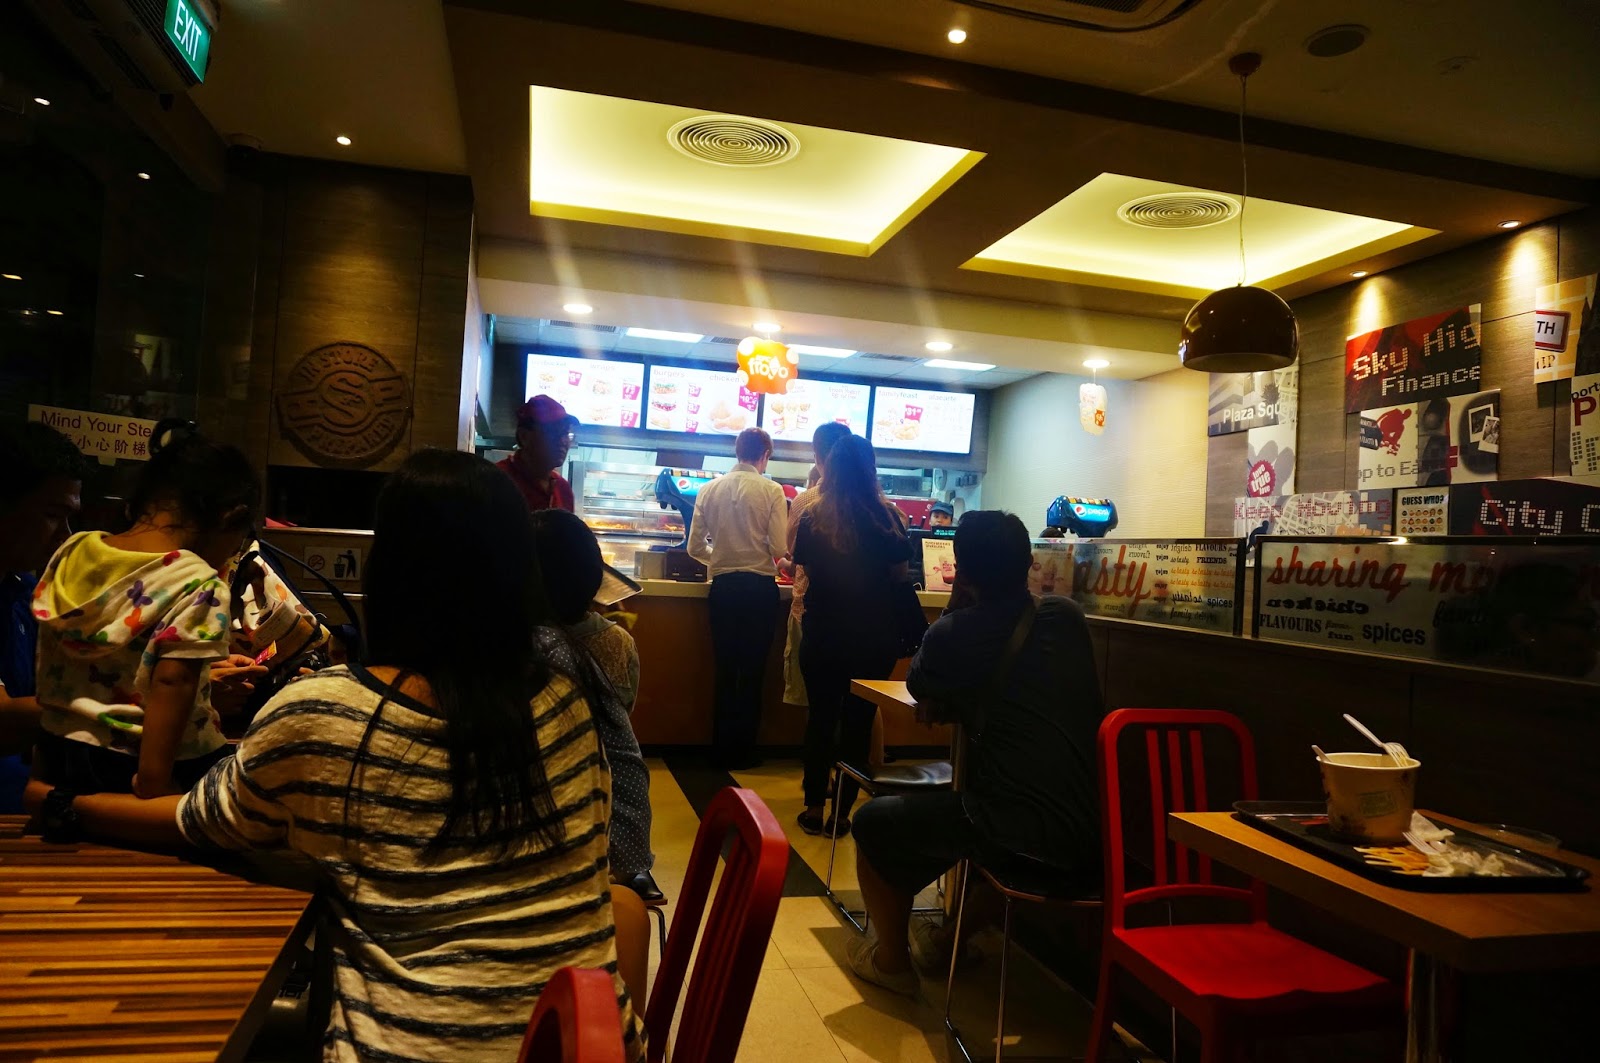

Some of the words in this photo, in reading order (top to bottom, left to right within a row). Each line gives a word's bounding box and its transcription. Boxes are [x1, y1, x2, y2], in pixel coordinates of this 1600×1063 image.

[174, 0, 202, 61] EXIT
[1353, 347, 1408, 381] Sky
[1381, 365, 1481, 396] Finance
[1571, 382, 1600, 402] port
[41, 410, 81, 429] Mind
[87, 416, 123, 434] Your
[127, 422, 153, 438] Ste
[1223, 407, 1254, 424] Plaza
[64, 432, 146, 456] 小心阶梯
[1376, 463, 1396, 478] to
[1250, 471, 1271, 493] true
[1234, 502, 1284, 522] Keep
[1297, 496, 1391, 520] Moving
[1402, 496, 1423, 506] GUESS
[1480, 499, 1563, 536] City
[1196, 556, 1227, 564] FRIENDS
[1267, 545, 1412, 604] sharing
[1207, 597, 1233, 608] spices
[1259, 613, 1322, 633] FLAVOURS
[1362, 622, 1427, 645] spices
[1328, 631, 1354, 642] fun
